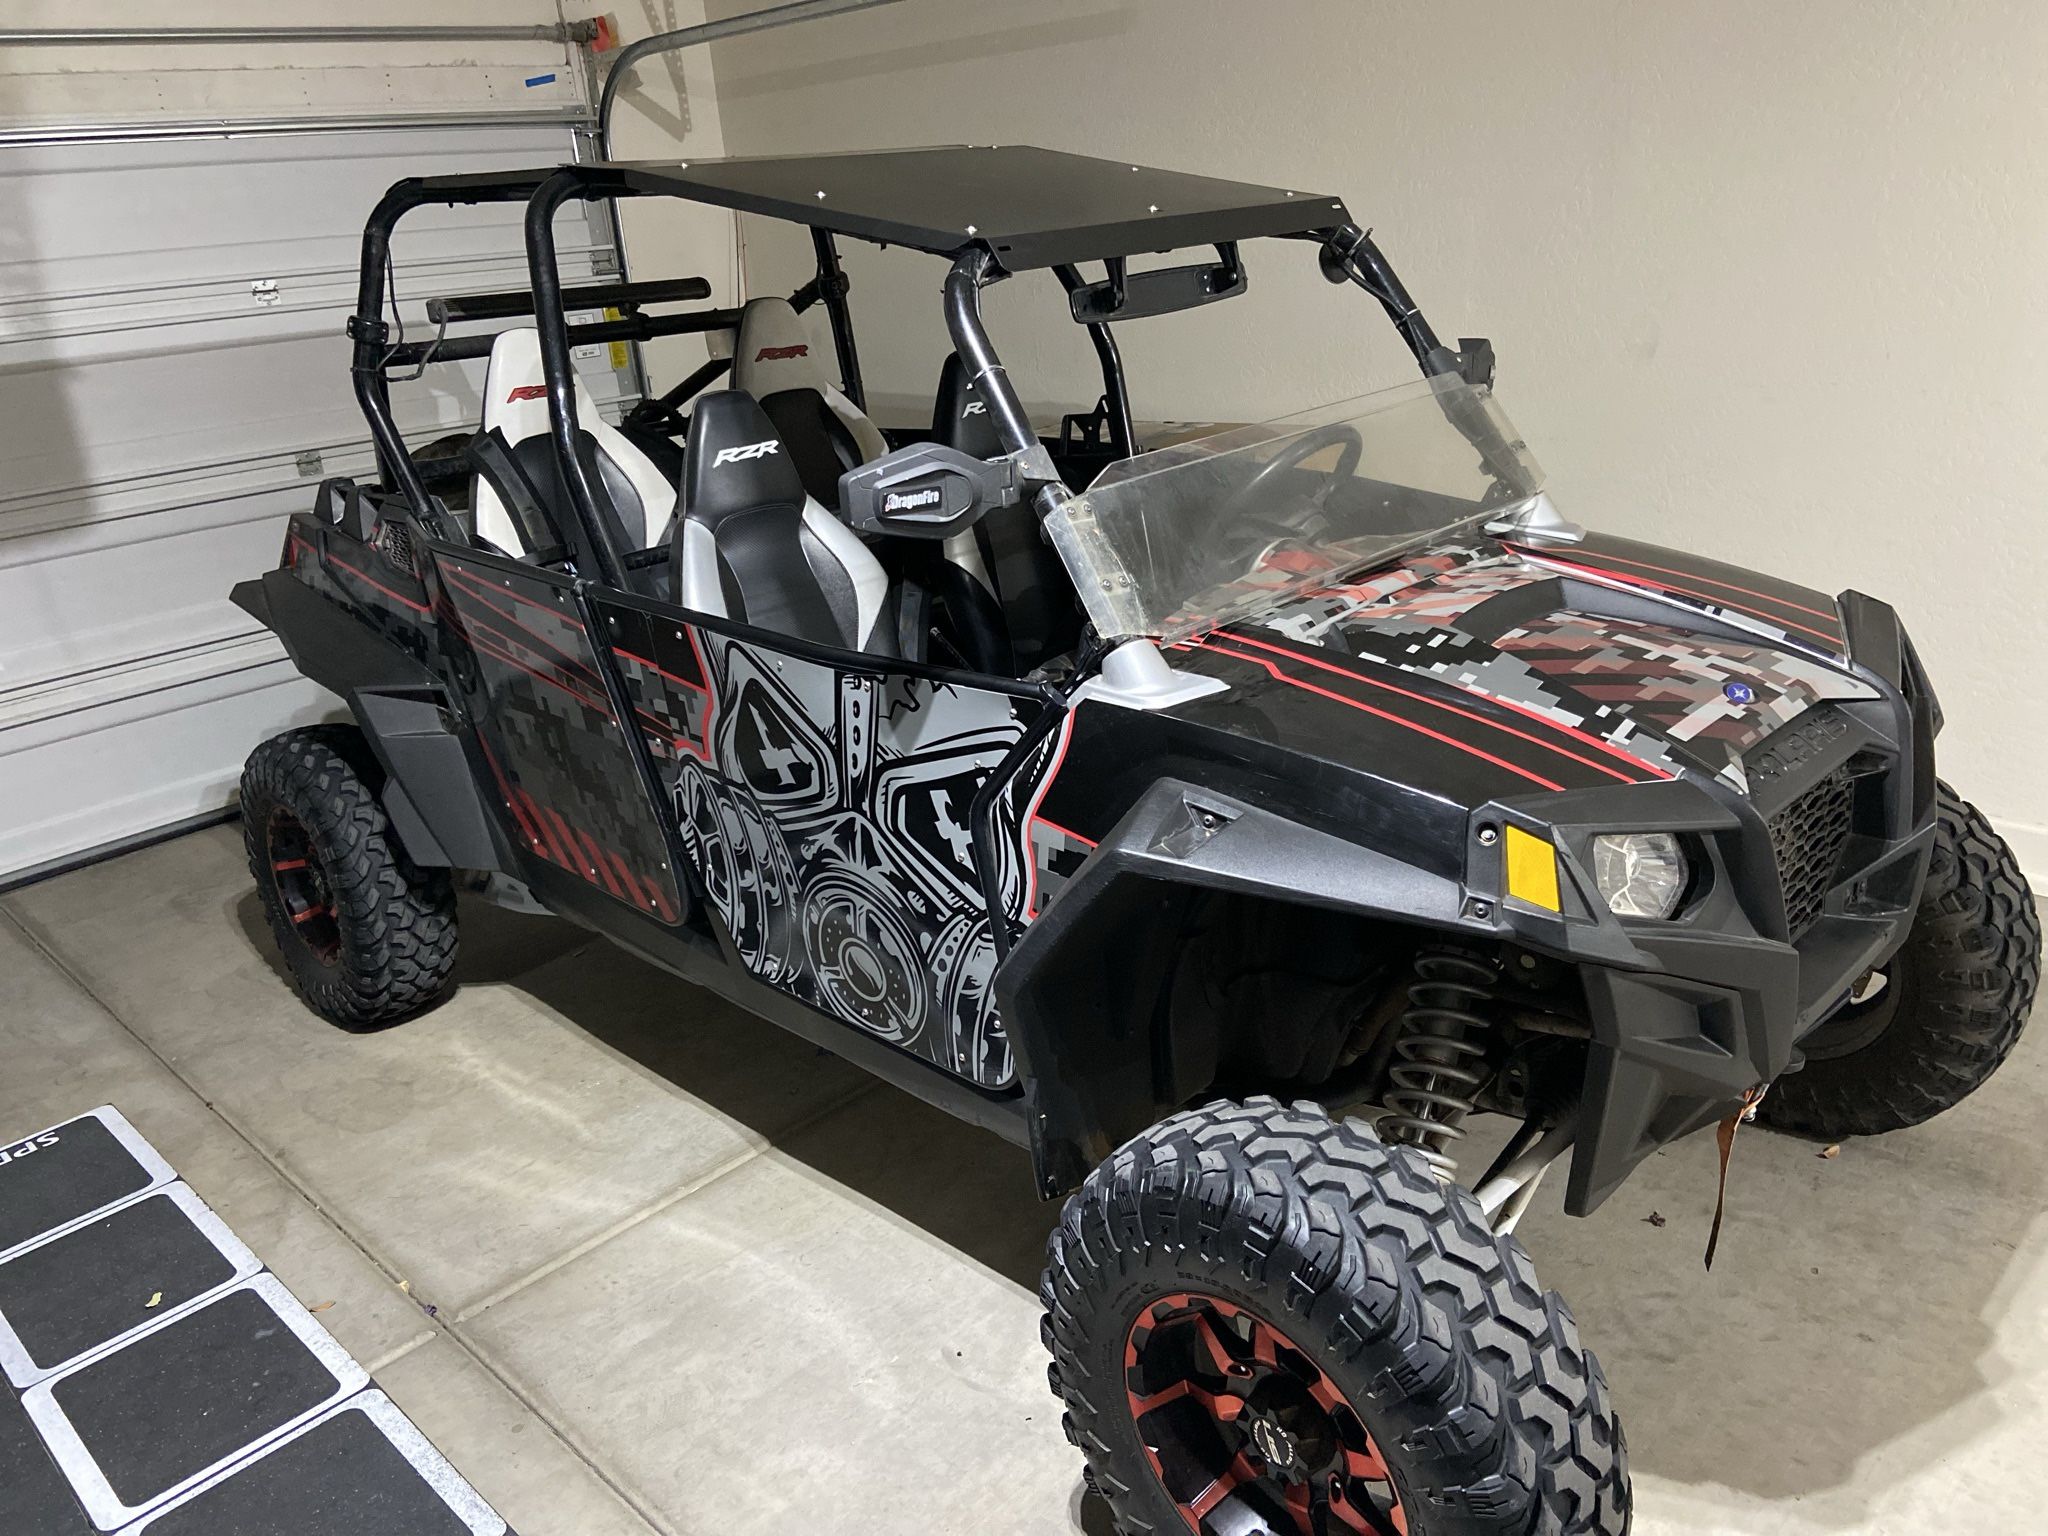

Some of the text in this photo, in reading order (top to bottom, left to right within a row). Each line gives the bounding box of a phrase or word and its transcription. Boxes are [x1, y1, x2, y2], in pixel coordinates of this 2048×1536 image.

[506, 384, 549, 404] RZ
[712, 439, 779, 469] RZR
[885, 490, 940, 512] DragonFire
